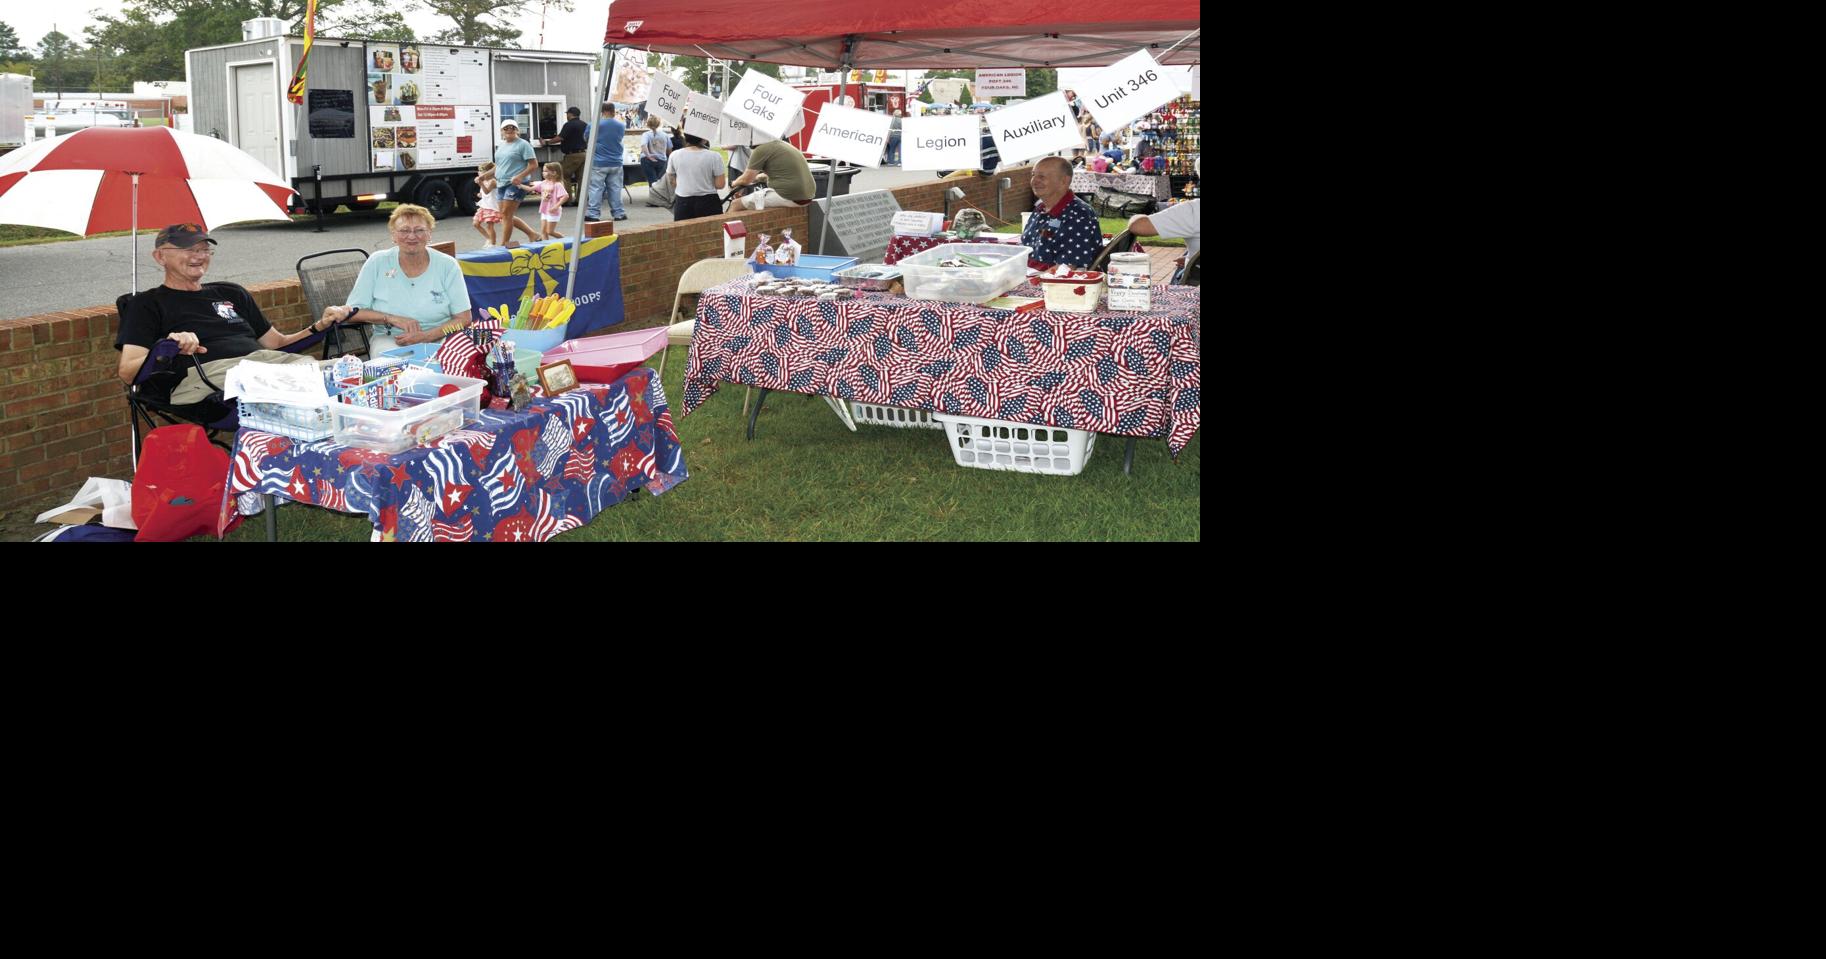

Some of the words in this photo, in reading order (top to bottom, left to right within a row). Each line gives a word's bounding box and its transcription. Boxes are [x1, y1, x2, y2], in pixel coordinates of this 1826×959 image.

[663, 84, 681, 99] Four
[752, 84, 783, 105] Four
[1094, 87, 1128, 109] Unit
[1127, 69, 1158, 92] 346
[657, 97, 677, 114] Oaks
[743, 98, 775, 121] Oaks
[689, 108, 719, 125] American
[818, 122, 883, 146] American
[1002, 113, 1067, 142] Auxiliary
[916, 136, 966, 151] Legion
